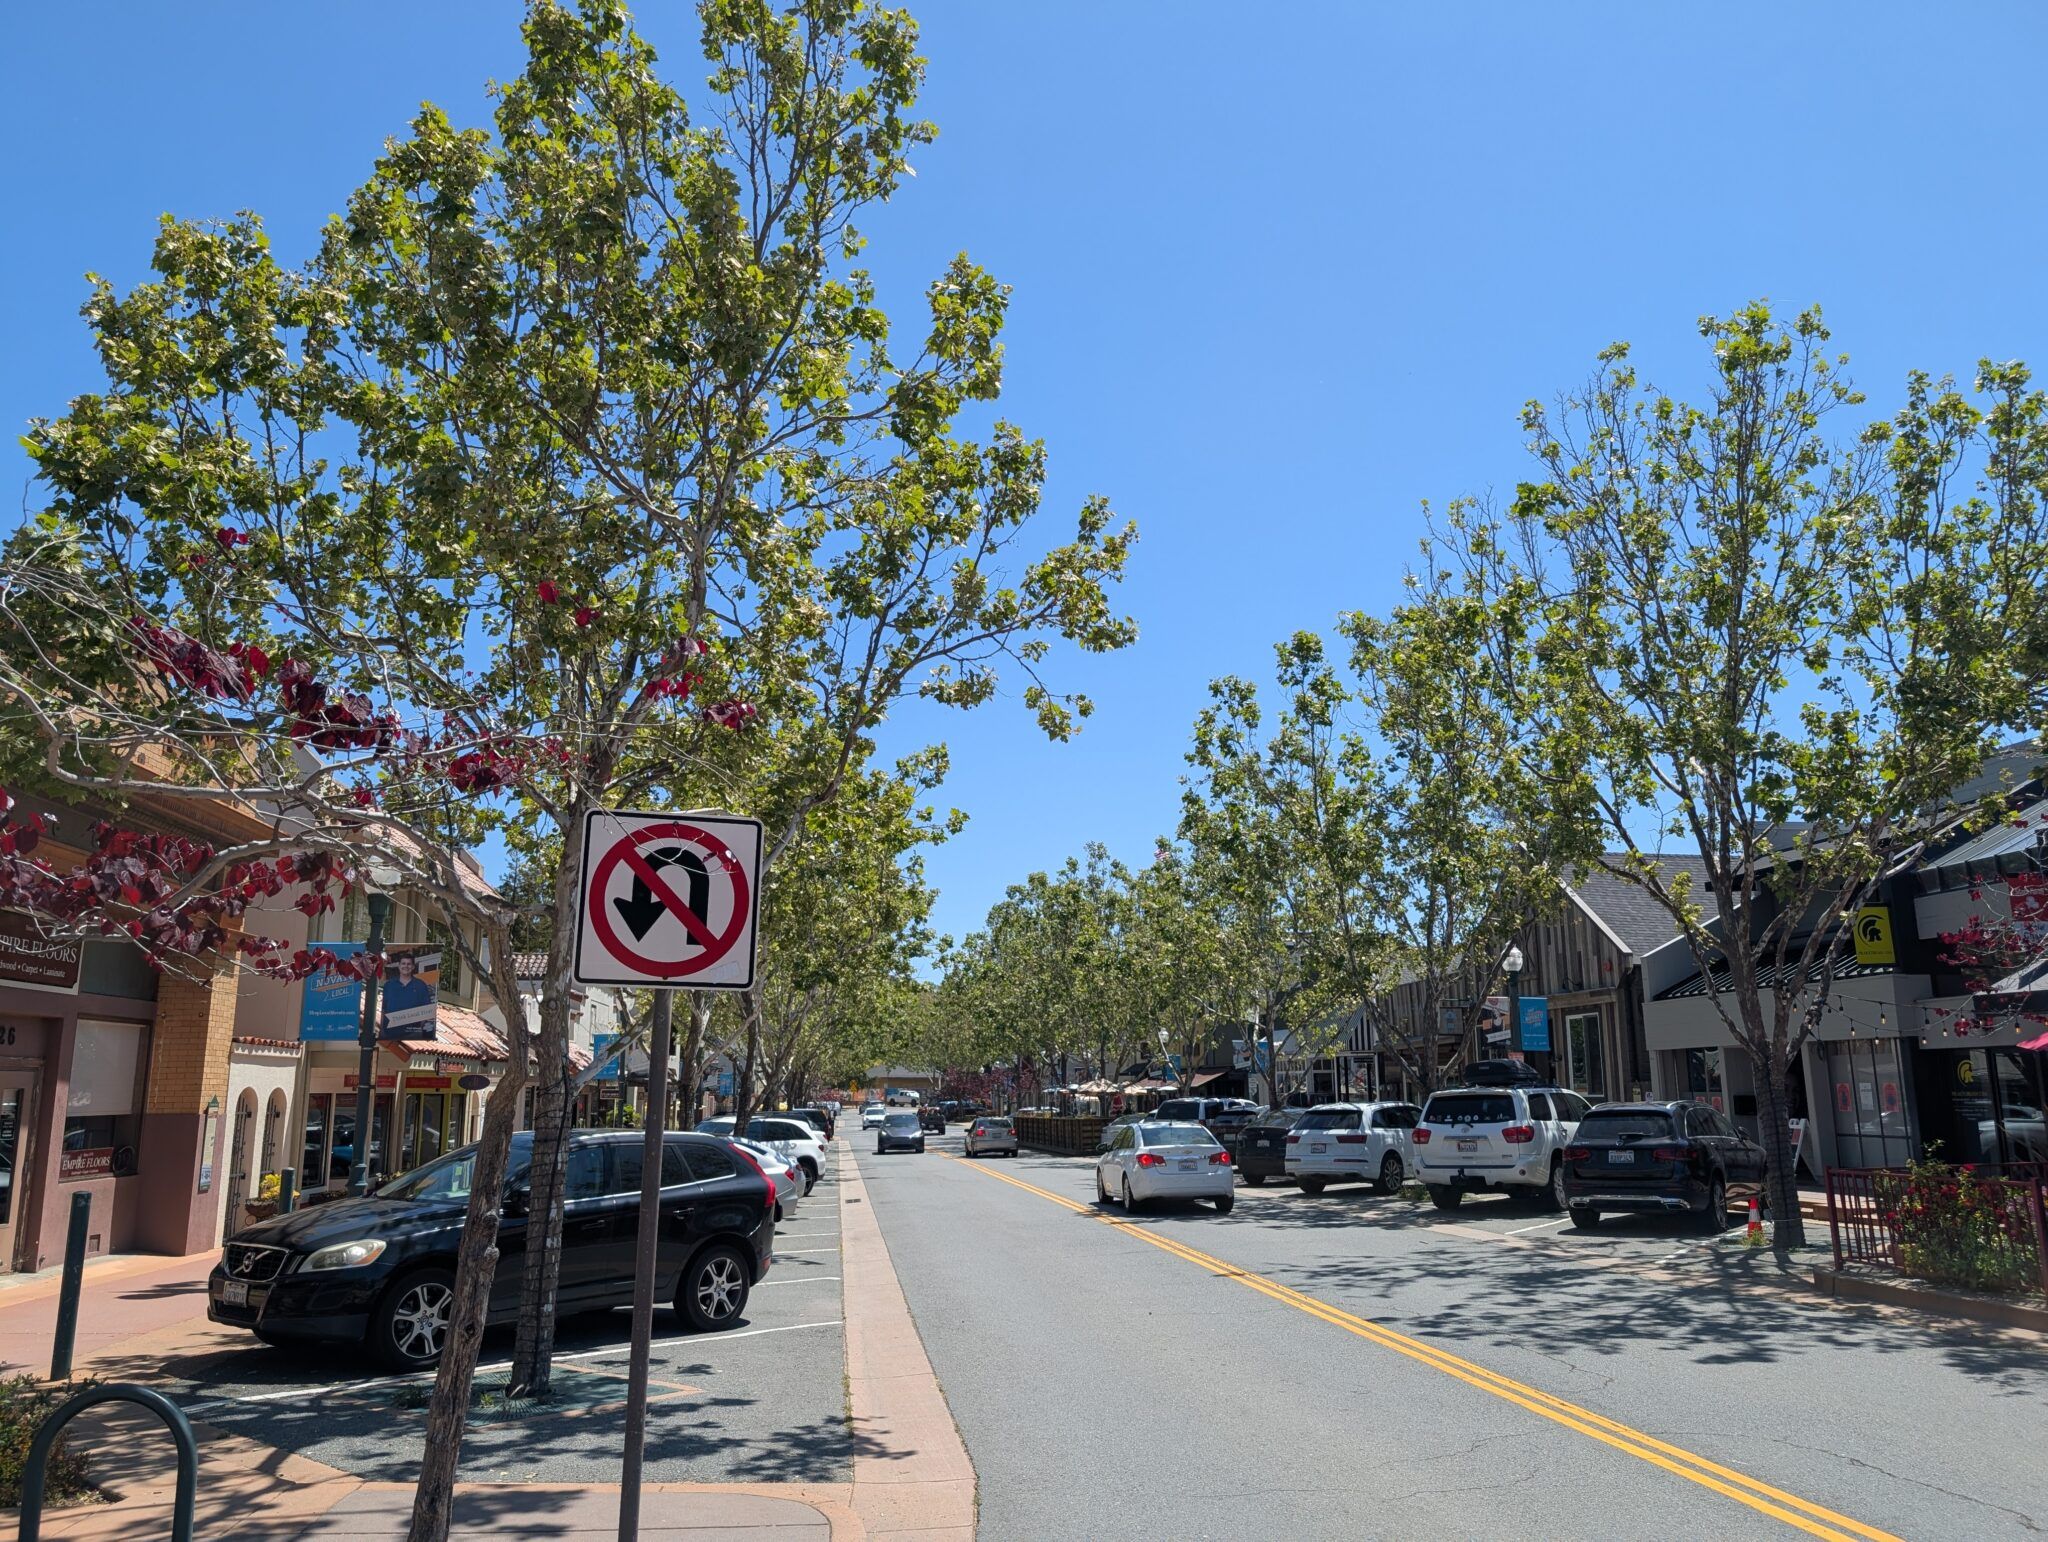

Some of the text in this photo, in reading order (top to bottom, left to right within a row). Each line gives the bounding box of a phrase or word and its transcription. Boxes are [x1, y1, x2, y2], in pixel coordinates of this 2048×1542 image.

[0, 935, 78, 963] PIRE FLOORS
[21, 963, 39, 975] Carpet
[43, 966, 66, 978] Laminate
[331, 989, 350, 998] LOCAL
[62, 1156, 110, 1170] EMPIRE FLOORS
